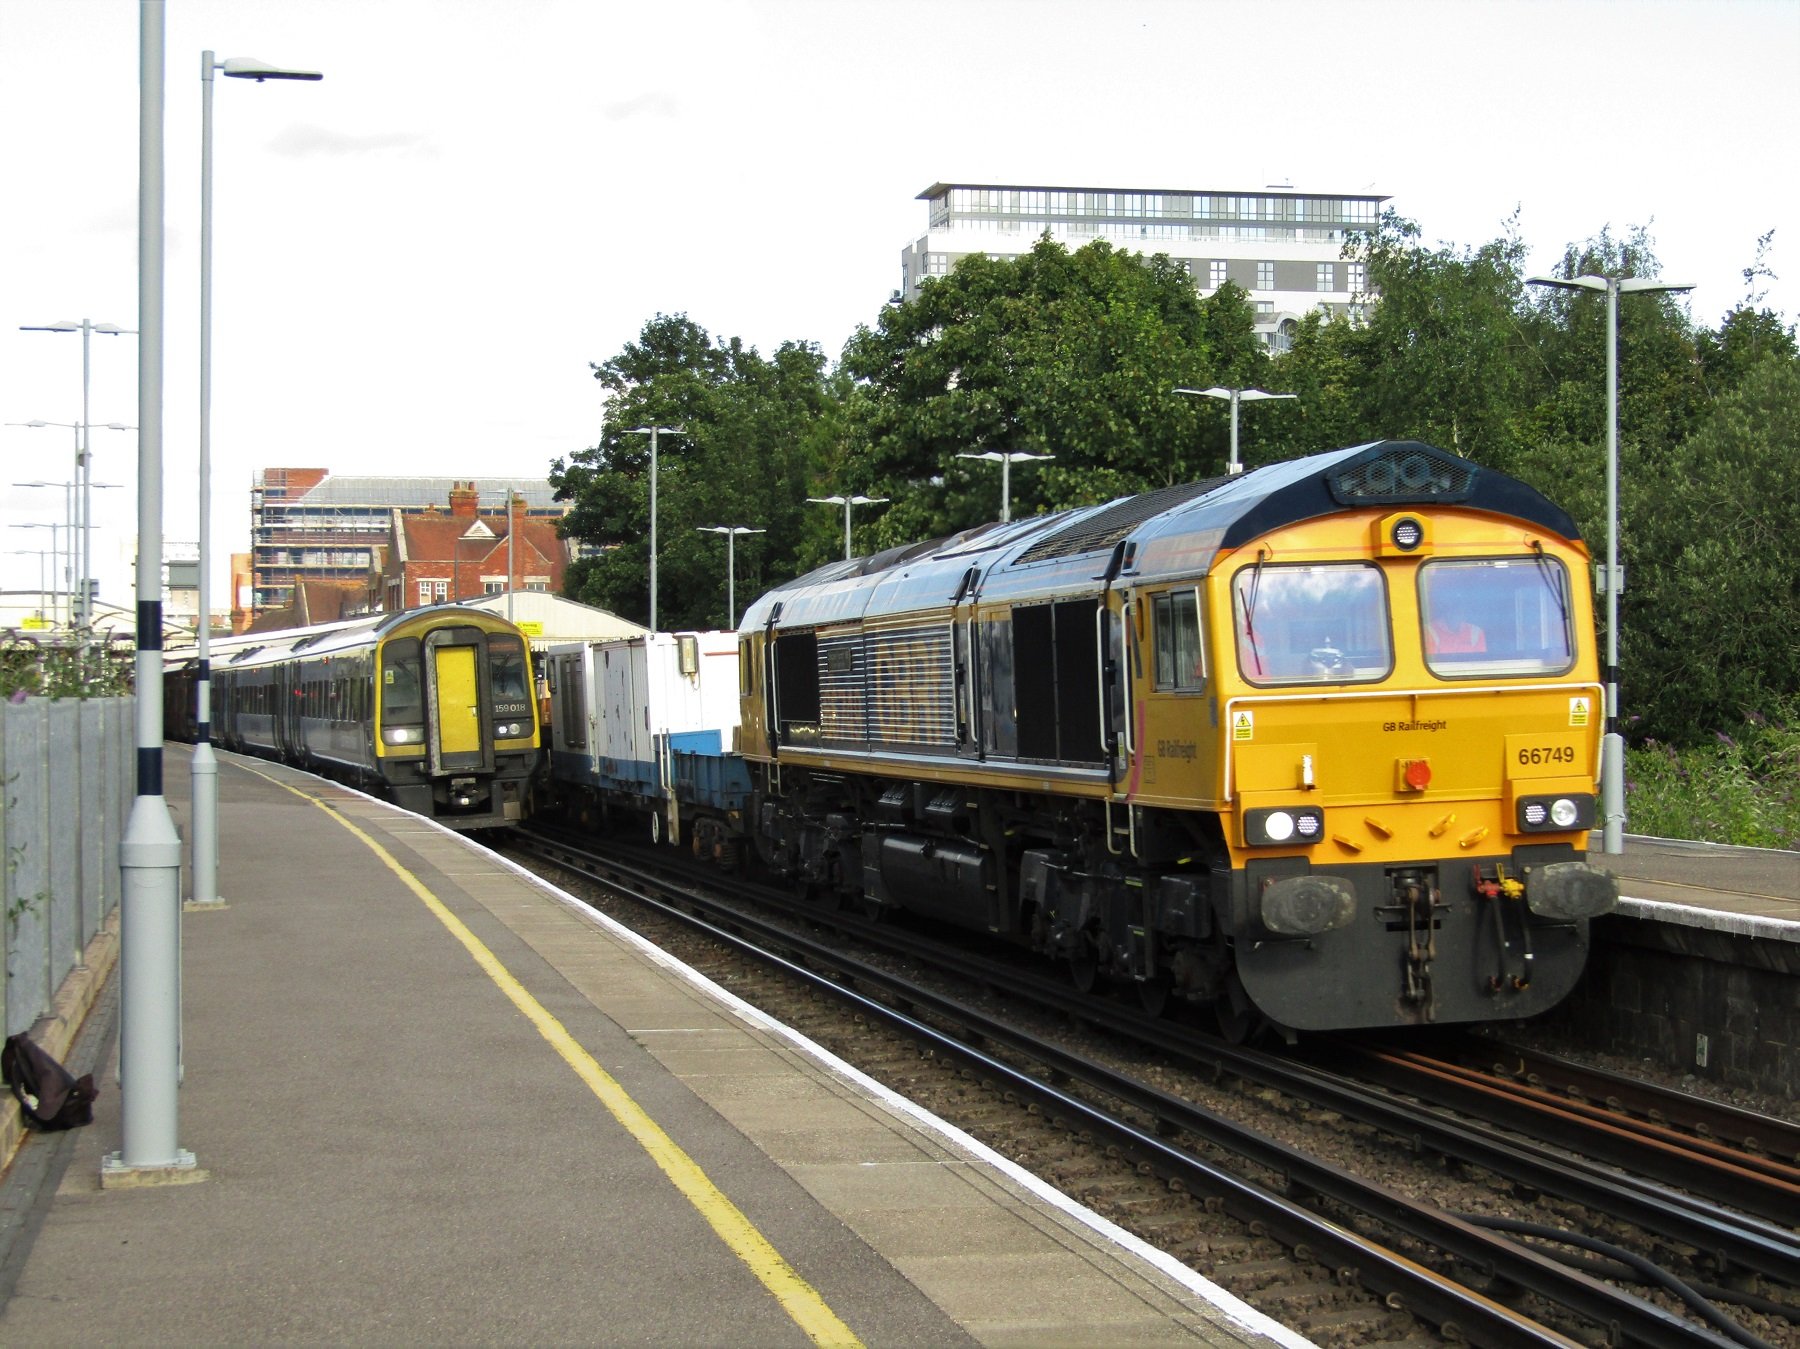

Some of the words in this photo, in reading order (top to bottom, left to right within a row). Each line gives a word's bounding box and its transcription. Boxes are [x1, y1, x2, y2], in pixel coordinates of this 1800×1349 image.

[510, 703, 526, 712] 018
[1383, 722, 1396, 732] GB
[1399, 720, 1447, 733] Railfreight
[1518, 746, 1575, 766] 66749
